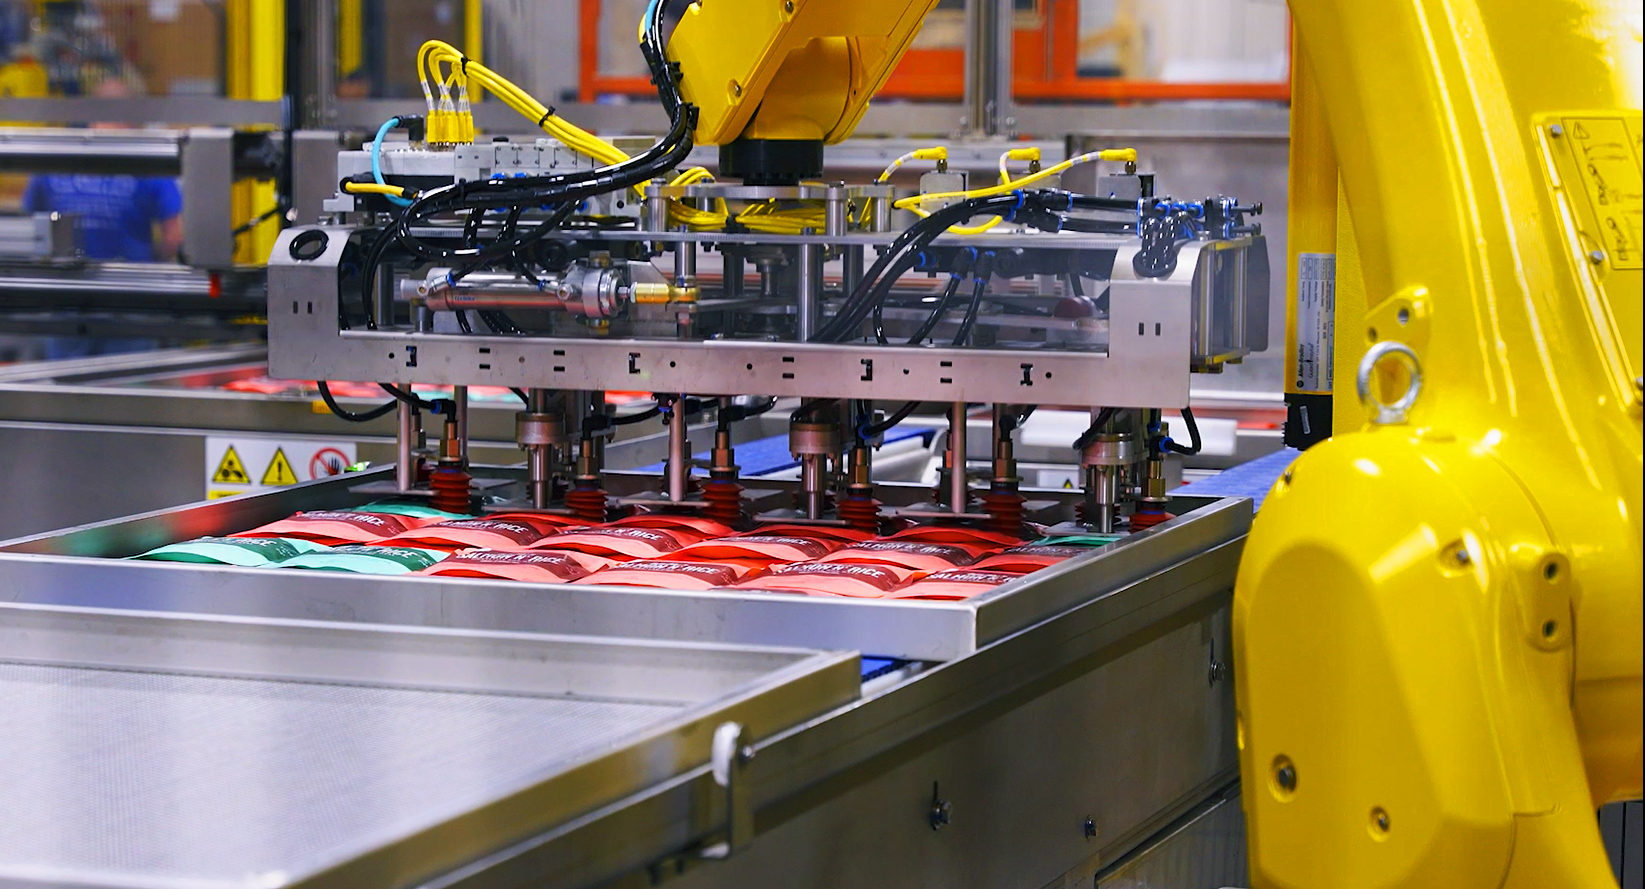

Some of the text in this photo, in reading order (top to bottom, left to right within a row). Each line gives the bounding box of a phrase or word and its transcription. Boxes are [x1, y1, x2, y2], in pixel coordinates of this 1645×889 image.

[628, 530, 664, 541] RICE
[456, 552, 514, 561] SALMON
[528, 555, 566, 565] RICE
[681, 565, 720, 575] RICE
[846, 566, 885, 579] RICE
